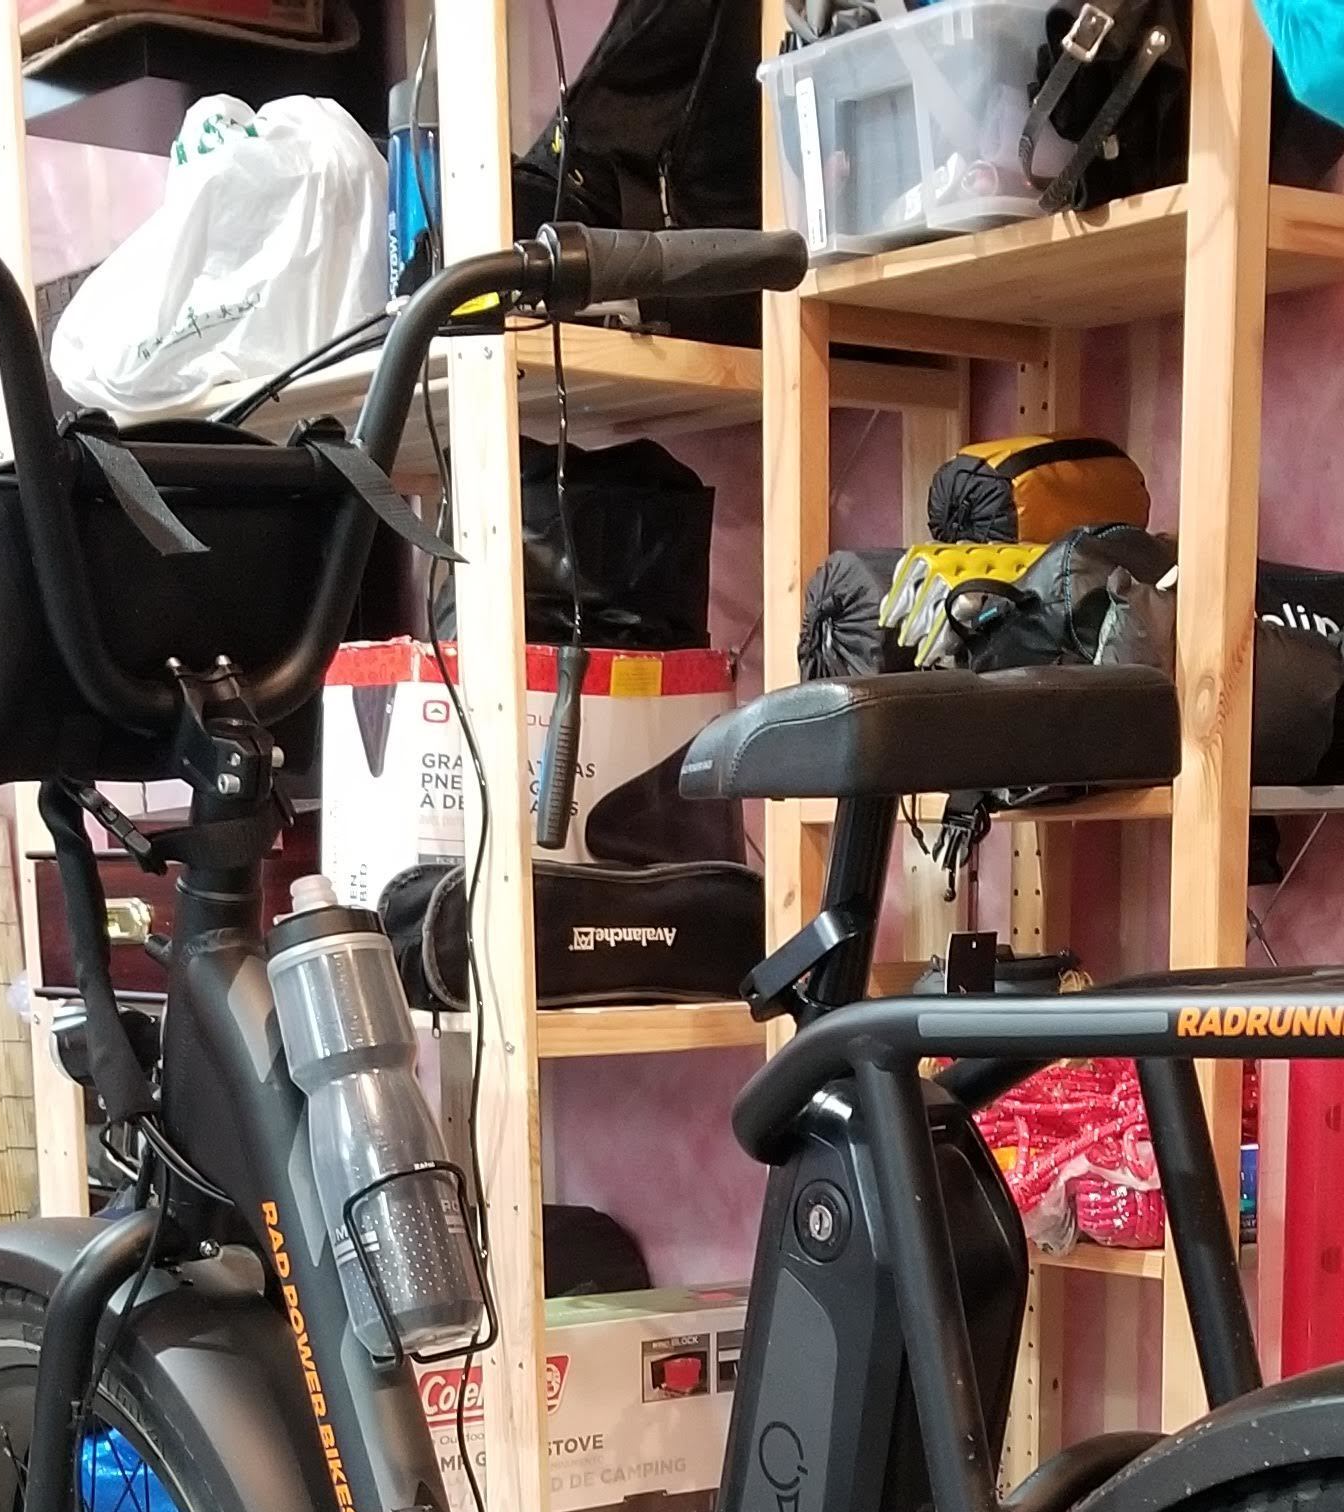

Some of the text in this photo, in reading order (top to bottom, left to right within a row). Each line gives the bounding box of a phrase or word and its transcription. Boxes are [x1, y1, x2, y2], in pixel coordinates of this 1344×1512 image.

[595, 927, 677, 947] Avalanche
[261, 1201, 290, 1279] RAD
[283, 1284, 329, 1418] POWER
[569, 1472, 595, 1488] DE
[600, 1457, 687, 1485] CAMPING
